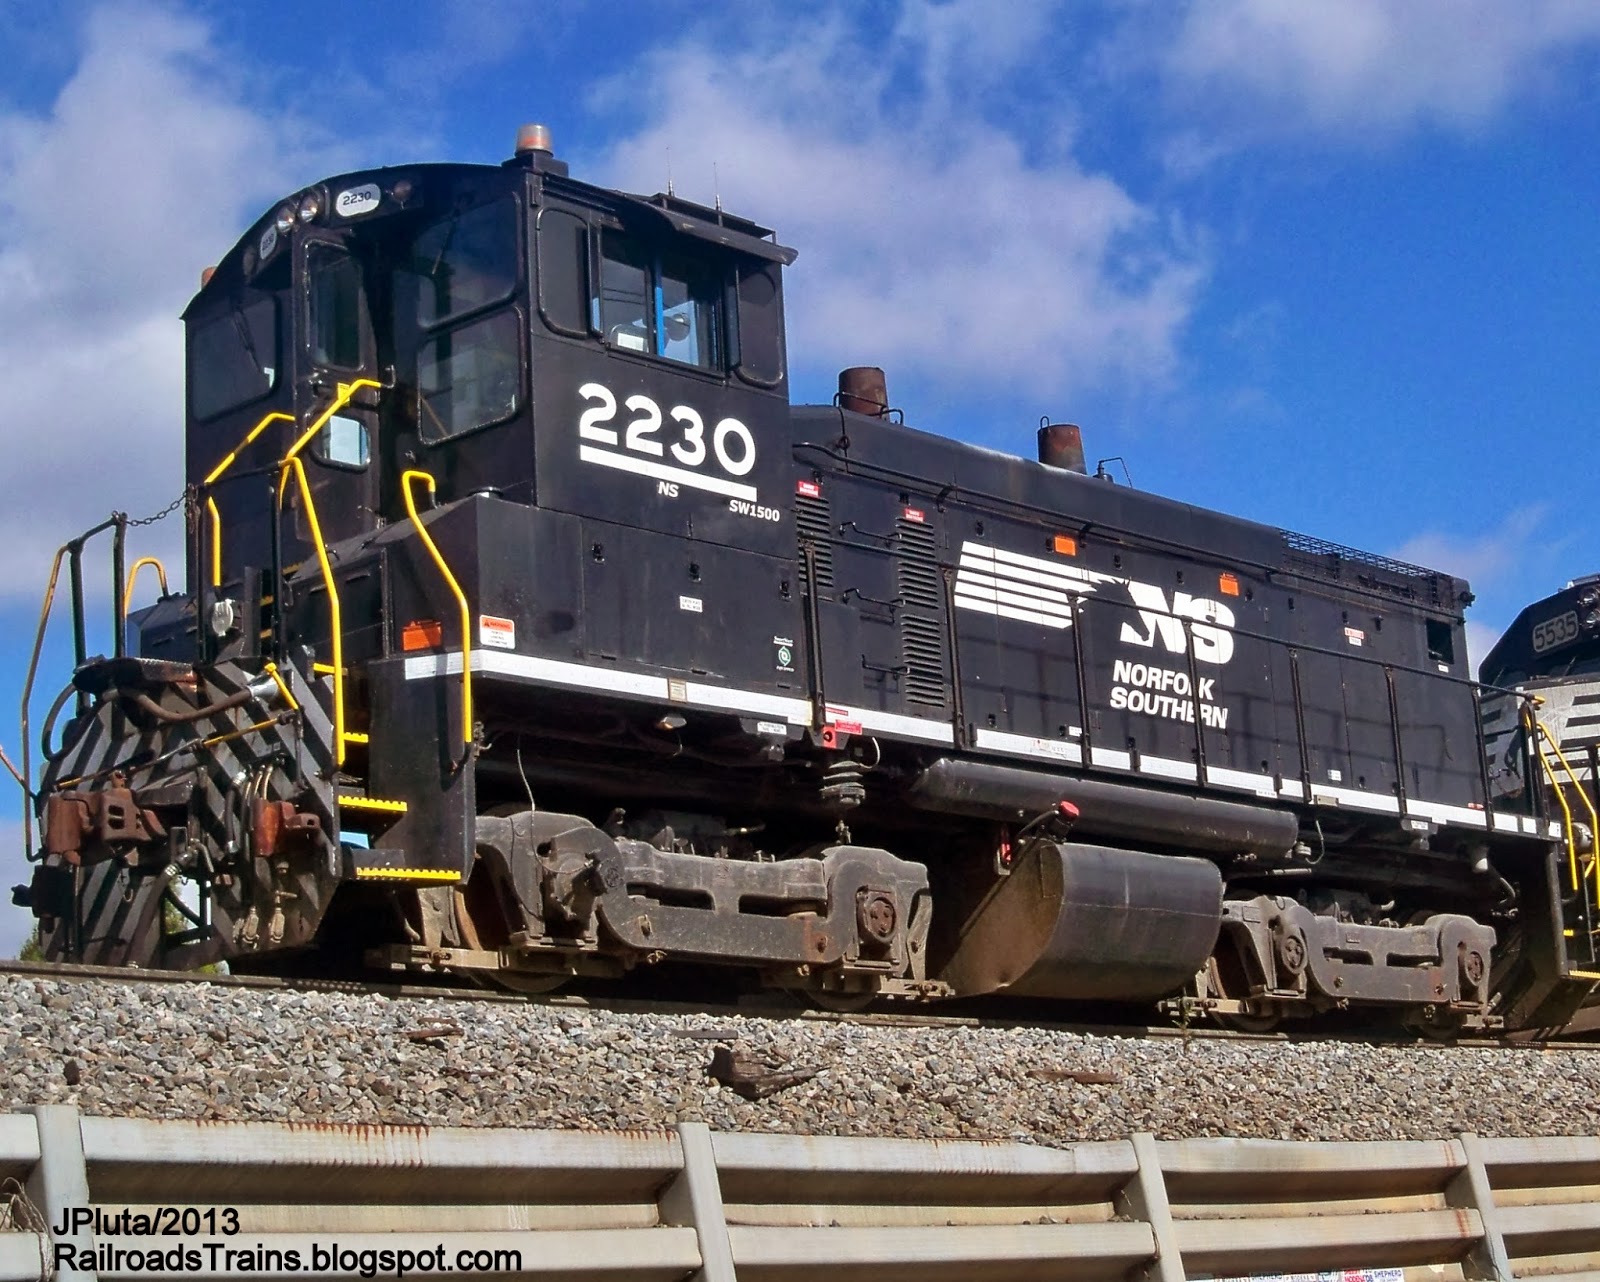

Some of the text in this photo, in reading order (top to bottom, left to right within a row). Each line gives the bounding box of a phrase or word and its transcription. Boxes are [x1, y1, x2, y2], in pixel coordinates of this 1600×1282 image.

[342, 191, 372, 205] 2230
[578, 382, 756, 476] 2230
[657, 481, 679, 498] NS
[729, 499, 780, 522] SW1500
[1535, 612, 1577, 650] 5535
[1110, 686, 1228, 729] SOUTHERN
